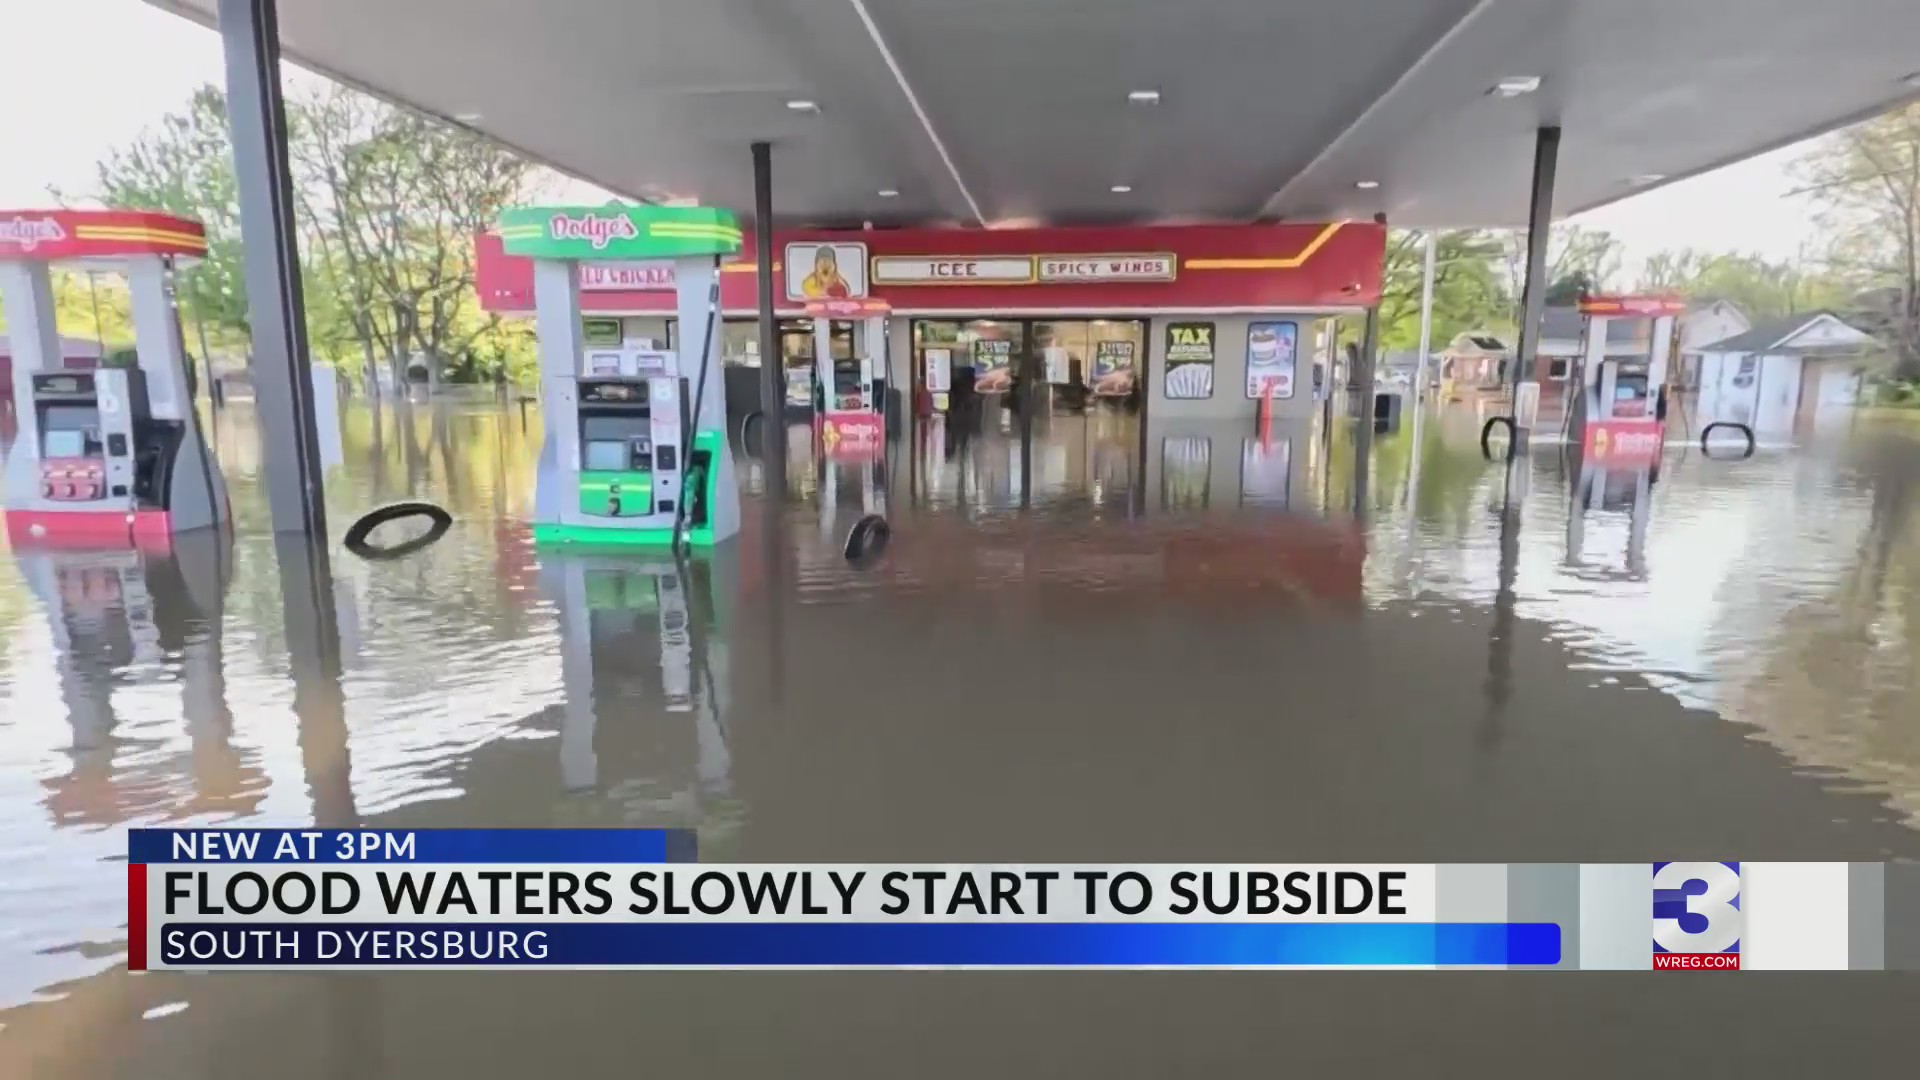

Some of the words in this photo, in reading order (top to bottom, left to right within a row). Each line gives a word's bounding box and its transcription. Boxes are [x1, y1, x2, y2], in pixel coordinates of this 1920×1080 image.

[551, 213, 638, 249] Dodge's
[930, 263, 977, 277] ICEE
[1047, 262, 1099, 276] SPICY
[1170, 327, 1210, 345] TAX
